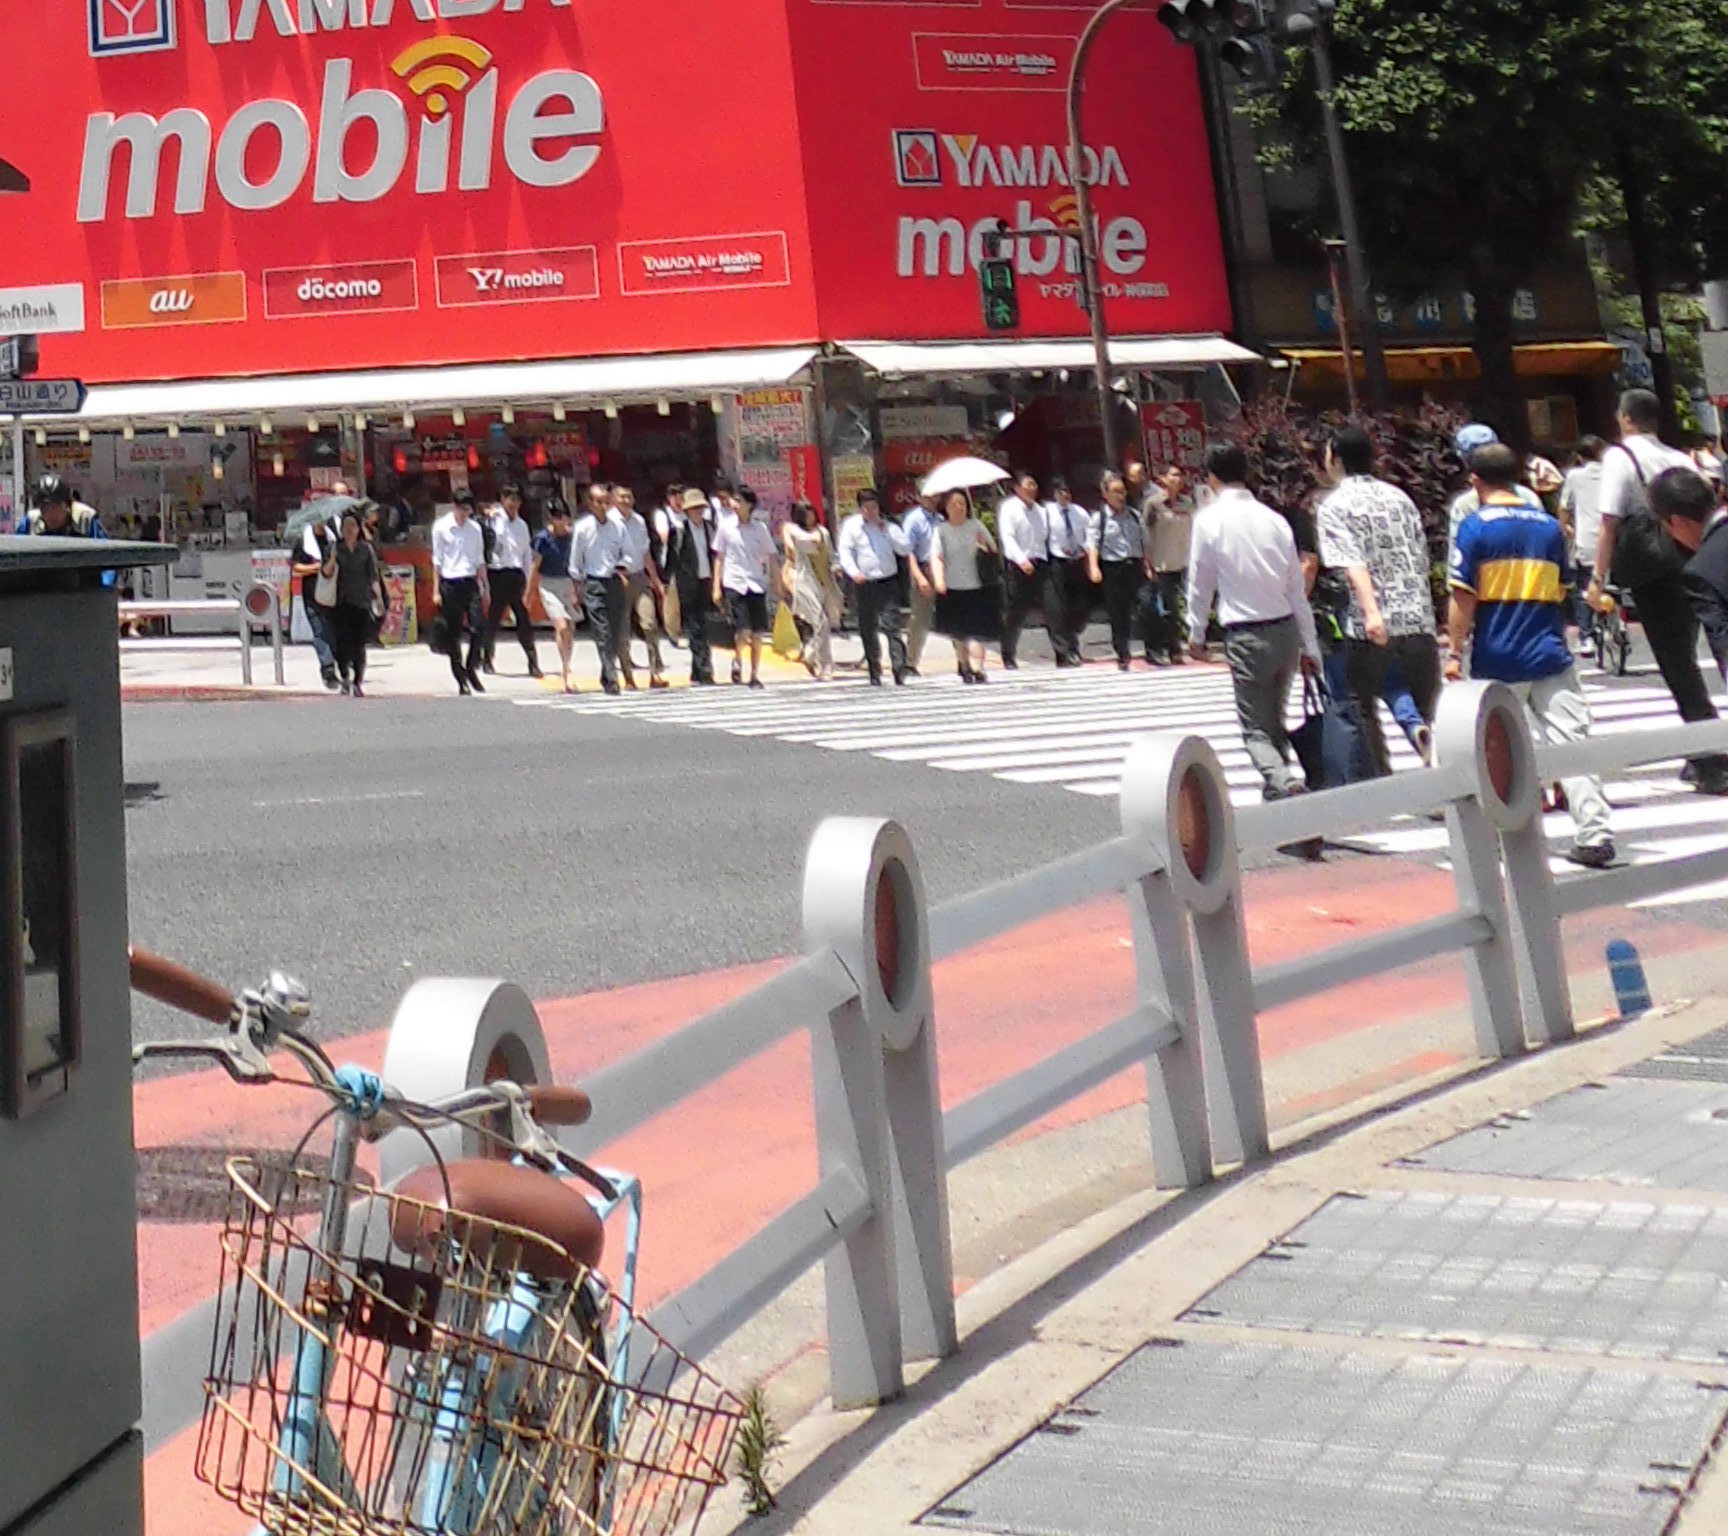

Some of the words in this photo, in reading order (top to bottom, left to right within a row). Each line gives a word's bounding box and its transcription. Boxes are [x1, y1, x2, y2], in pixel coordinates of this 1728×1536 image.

[75, 50, 606, 222] mobile
[940, 133, 1130, 187] YAMADA
[642, 255, 696, 272] YAMADA
[149, 288, 194, 313] au
[296, 275, 382, 301] docomo
